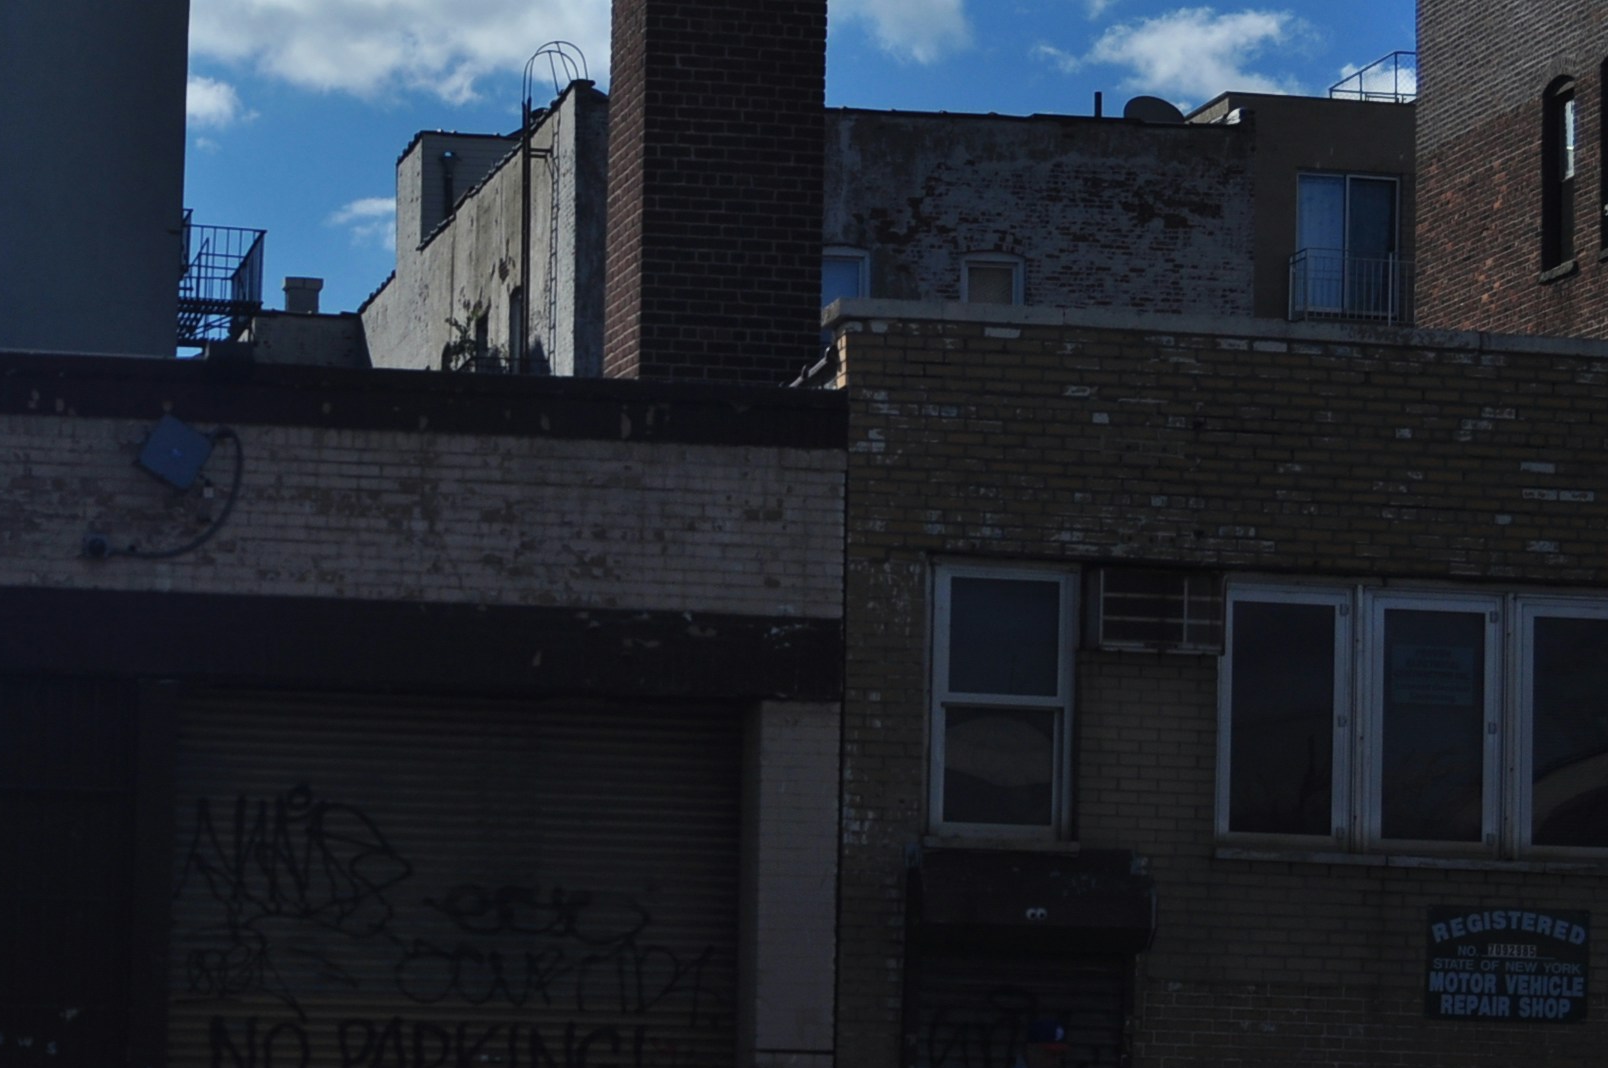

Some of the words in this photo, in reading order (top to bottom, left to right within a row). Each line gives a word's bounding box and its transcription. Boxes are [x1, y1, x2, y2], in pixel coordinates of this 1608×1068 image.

[1431, 910, 1587, 946] REGISTERED
[1457, 945, 1480, 958] NO.
[1433, 957, 1475, 970] STATE
[1480, 959, 1500, 972] OF
[1505, 961, 1538, 974] NEW
[1543, 963, 1582, 975] YORK
[1428, 971, 1498, 994] MOTOR
[1504, 974, 1585, 998] VEHICLE
[1440, 994, 1511, 1018] REPAIR
[1518, 998, 1572, 1019] SHOP
